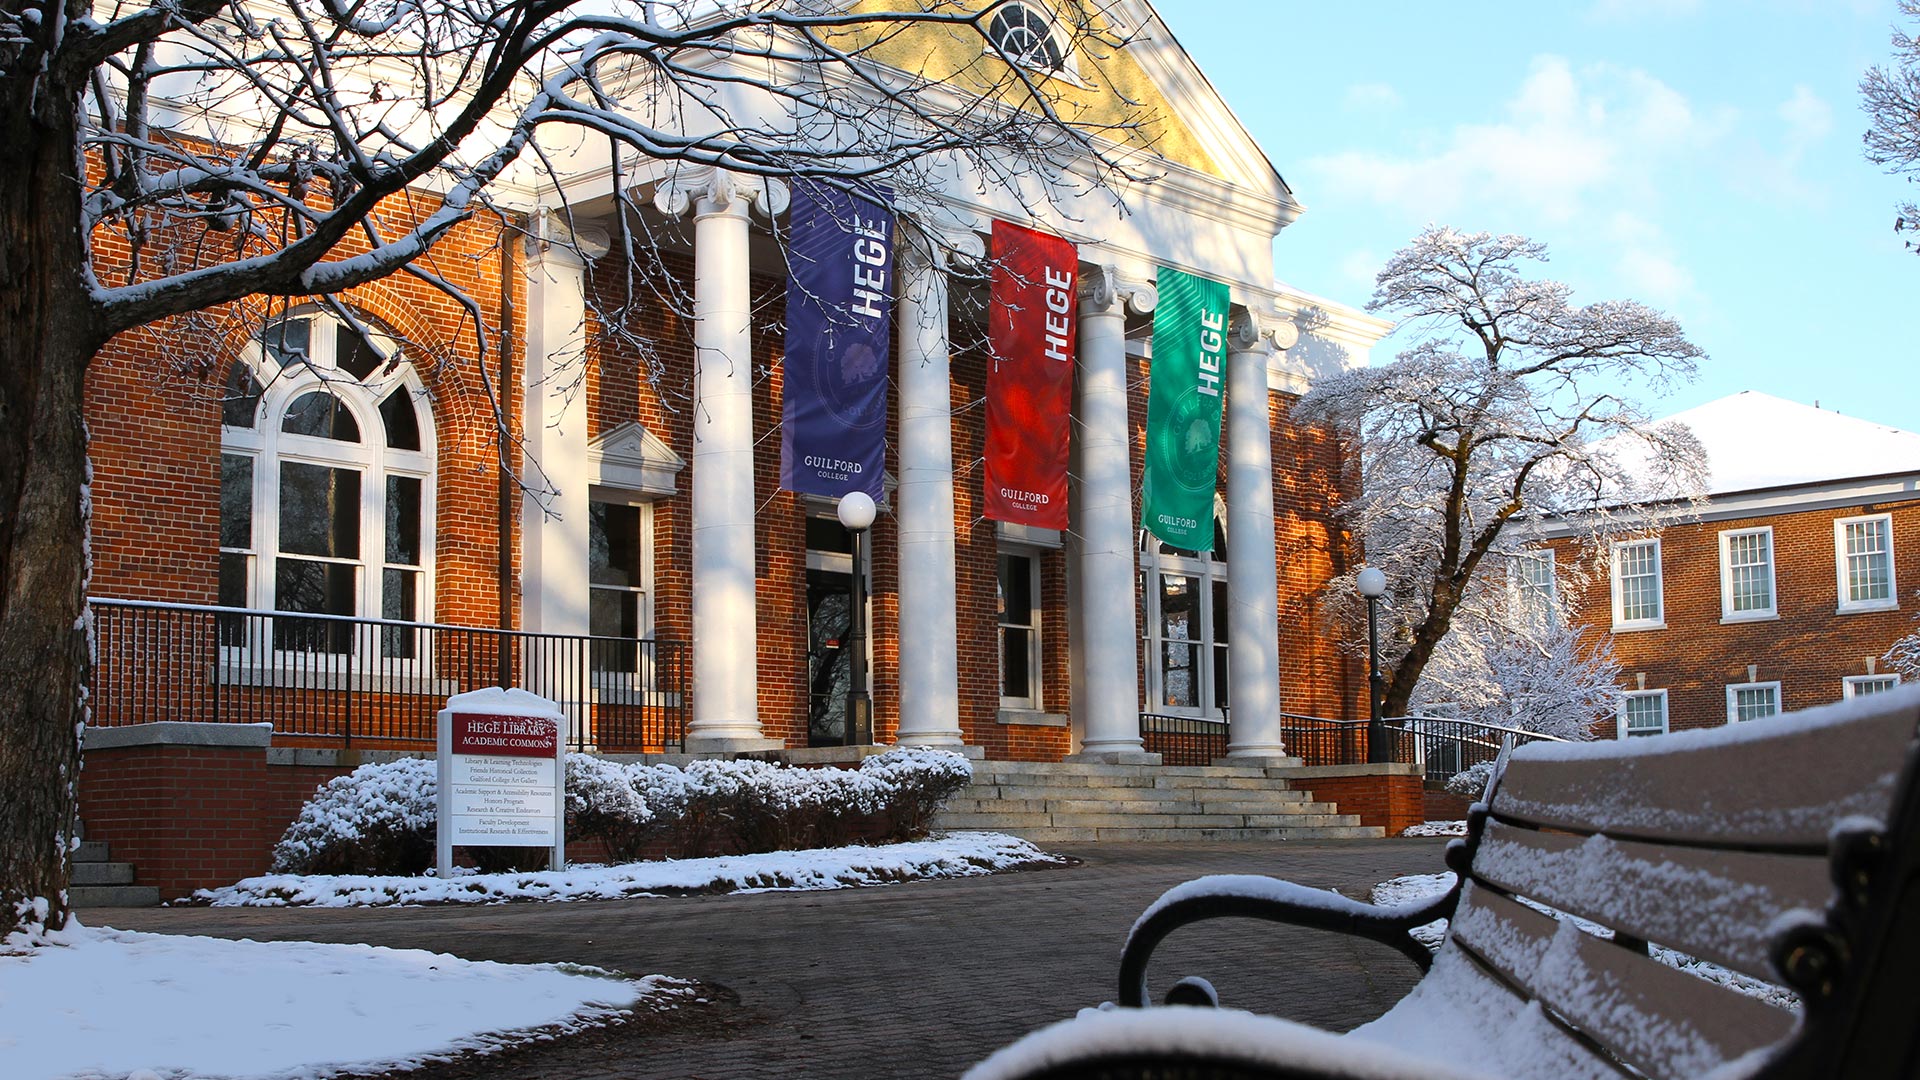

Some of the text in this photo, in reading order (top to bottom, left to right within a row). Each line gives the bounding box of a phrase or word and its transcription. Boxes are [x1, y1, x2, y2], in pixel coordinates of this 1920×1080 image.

[852, 214, 886, 318] HEGE
[1045, 266, 1071, 361] HEGE
[1198, 308, 1223, 397] HEGE
[804, 455, 862, 473] GUILFORD
[817, 470, 848, 481] COLLEGE
[1001, 488, 1049, 504] GUILFORD
[1012, 502, 1037, 511] COLLEGE
[1158, 514, 1197, 528] GUILFORD
[1167, 527, 1187, 535] COLLEGE
[467, 721, 545, 736] HEGE LIBRARY
[462, 736, 549, 748] ACADEMIC COMMONS
[465, 758, 482, 766] Library
[490, 759, 511, 767] Learning
[512, 759, 542, 767] Technologies
[492, 776, 510, 784] College
[520, 777, 538, 785] Gallery
[497, 819, 530, 827] Development
